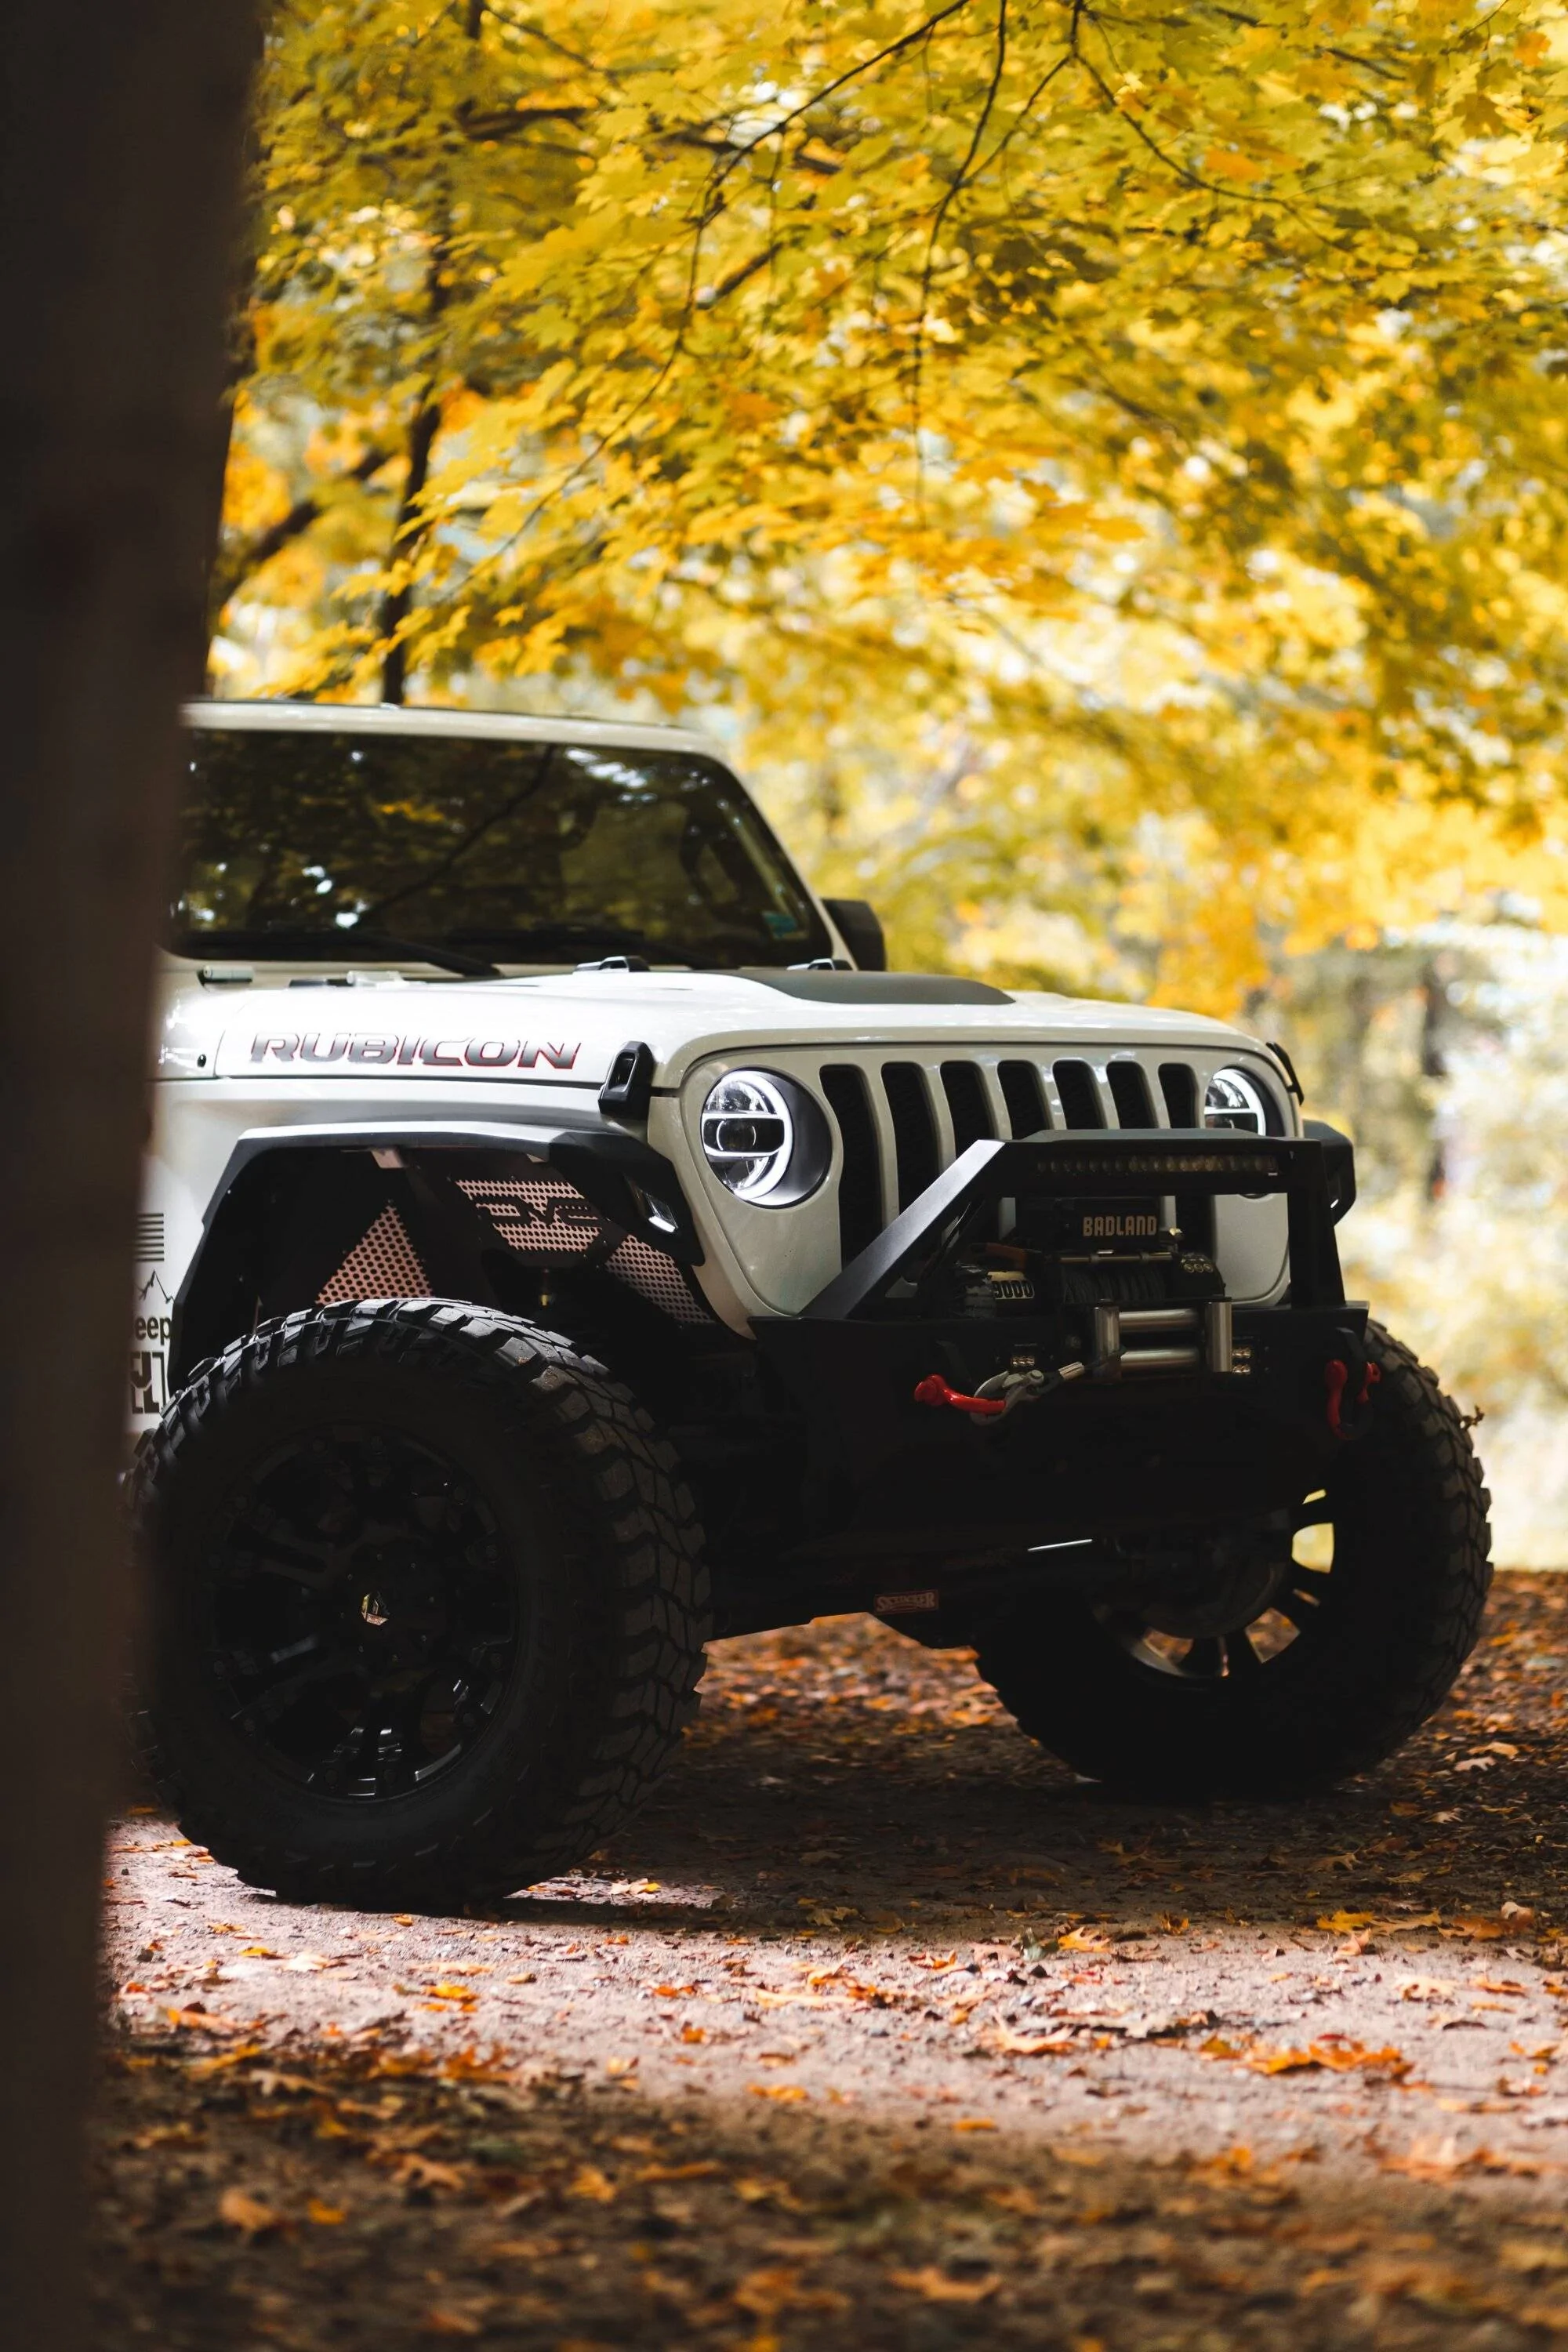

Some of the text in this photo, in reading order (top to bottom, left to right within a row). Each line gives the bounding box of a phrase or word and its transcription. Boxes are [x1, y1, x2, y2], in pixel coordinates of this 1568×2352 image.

[250, 1032, 581, 1069] RUBICON
[1083, 1215, 1157, 1236] BADLAND
[134, 1316, 173, 1346] eep
